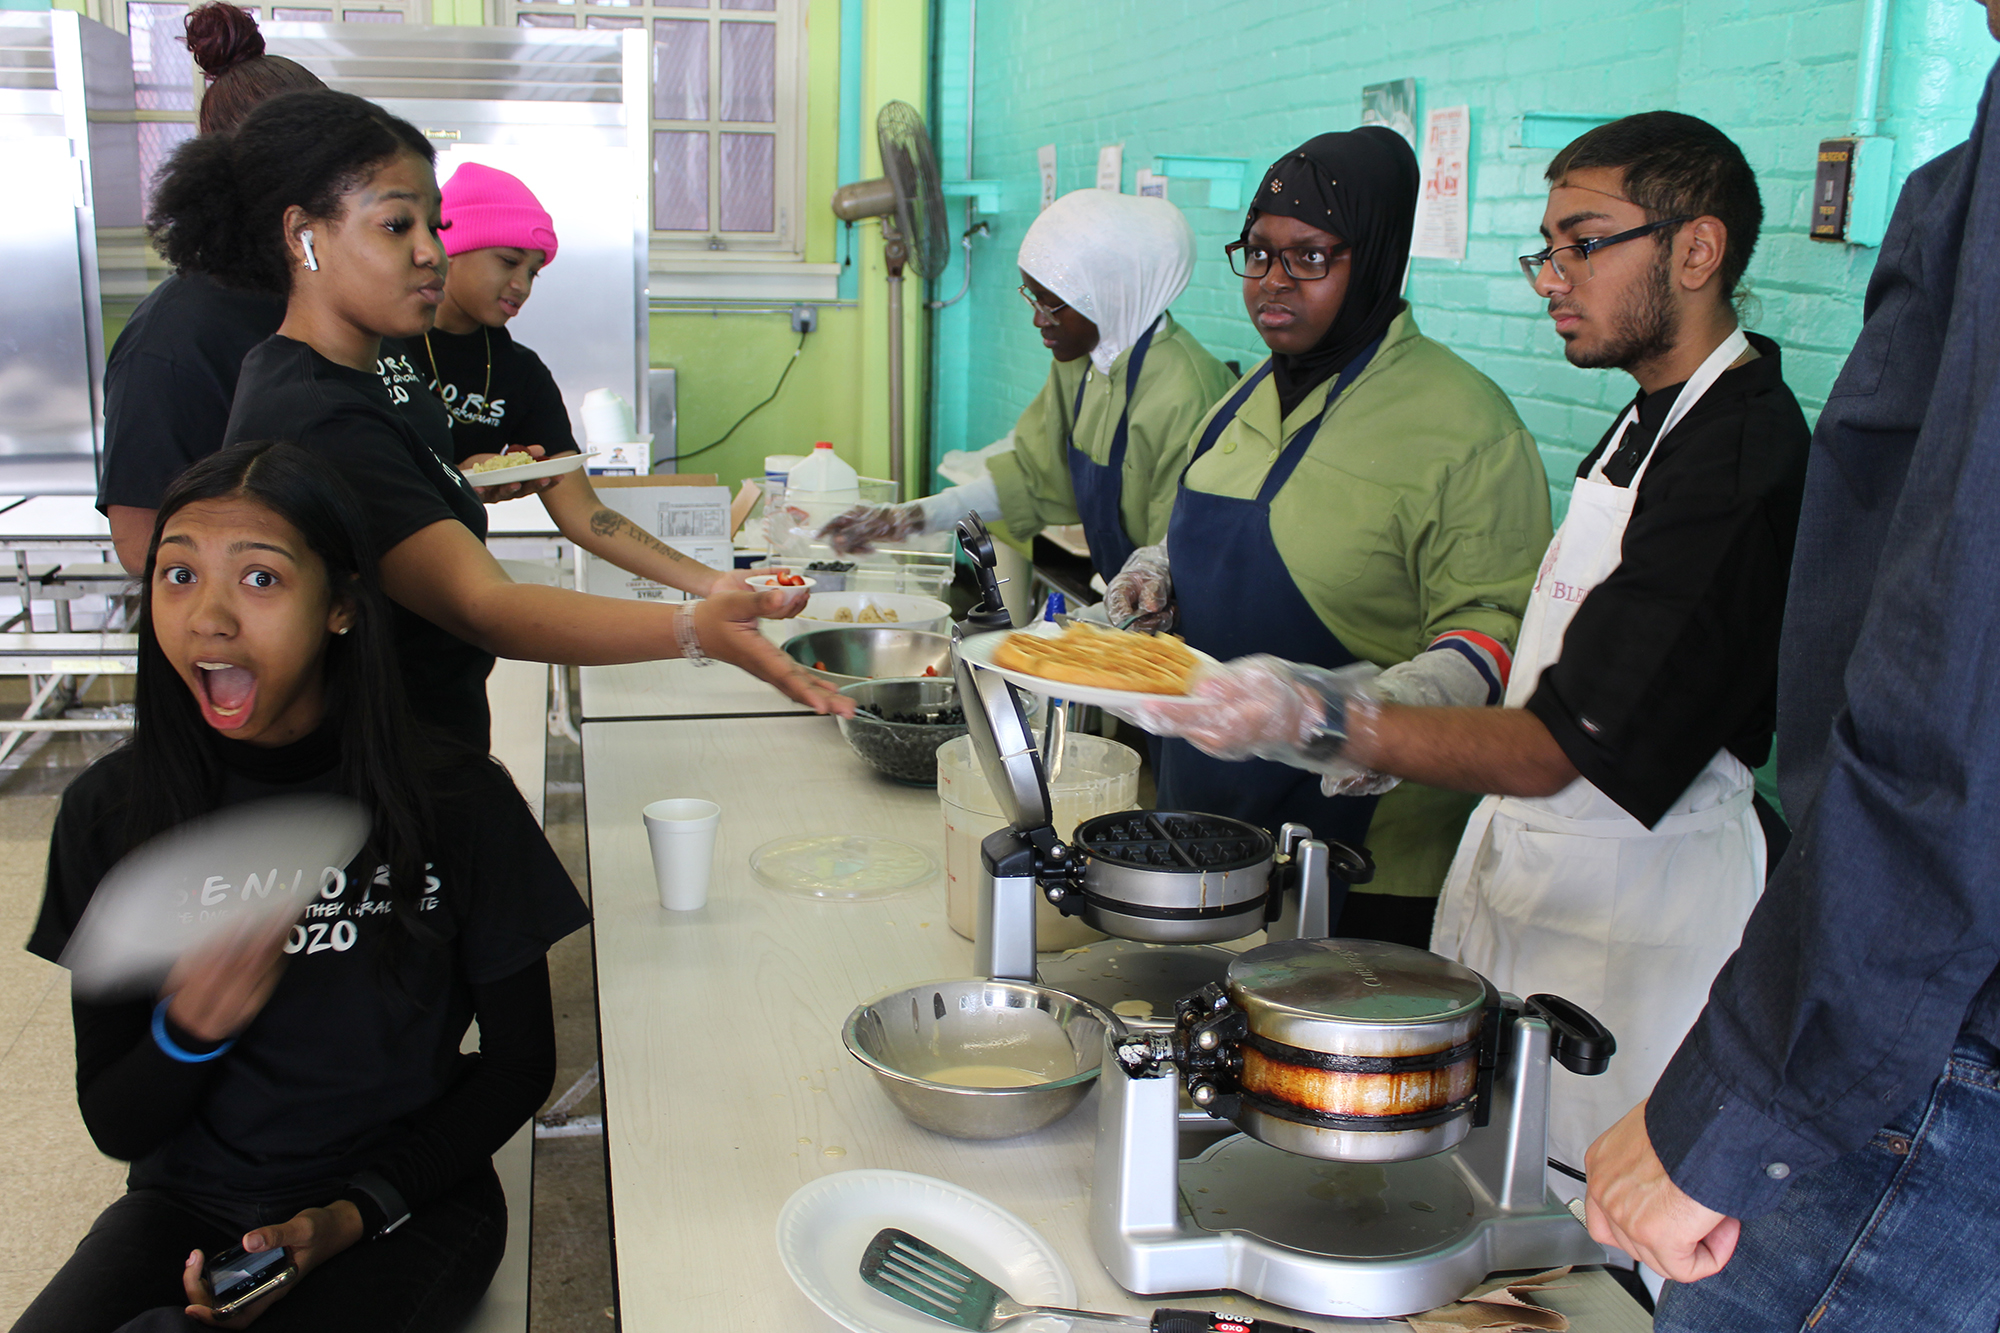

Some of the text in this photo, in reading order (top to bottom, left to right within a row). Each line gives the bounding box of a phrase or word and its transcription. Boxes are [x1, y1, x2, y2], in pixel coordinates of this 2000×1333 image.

[304, 900, 344, 920] THEY
[1214, 1310, 1254, 1325] GOOD
[1220, 1322, 1244, 1333] OXO
